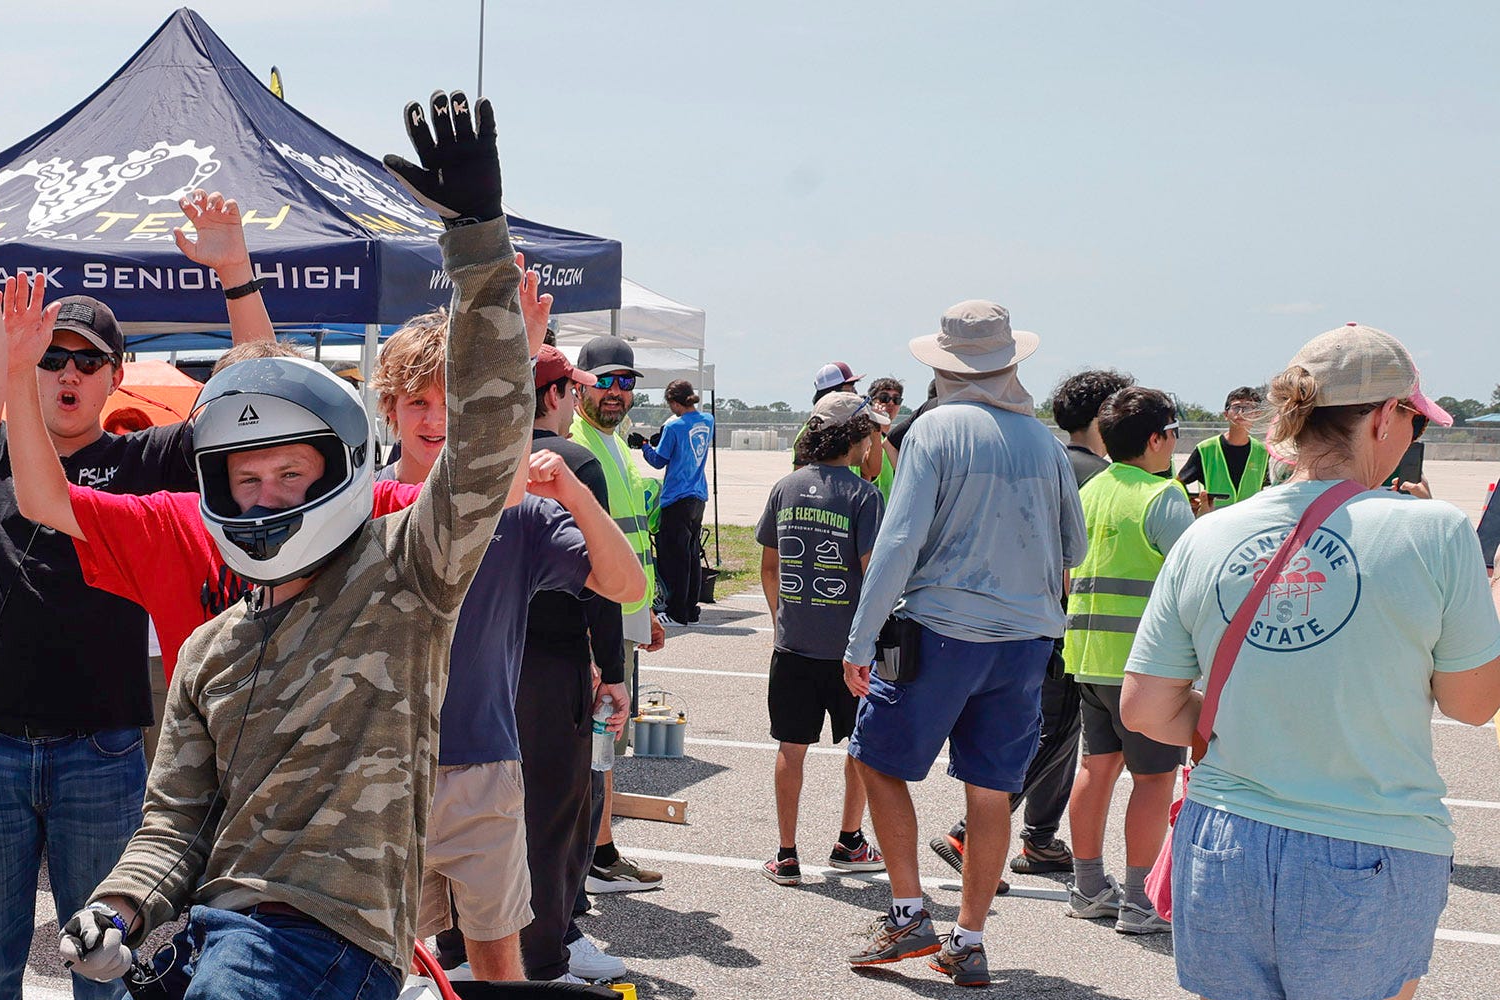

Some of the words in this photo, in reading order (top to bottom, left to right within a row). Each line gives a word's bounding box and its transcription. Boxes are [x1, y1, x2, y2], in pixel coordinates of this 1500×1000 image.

[255, 262, 360, 290] HIGH
[795, 506, 850, 532] ELECTRATHON
[1228, 529, 1348, 576] SUNINE
[1250, 617, 1325, 645] STATE
